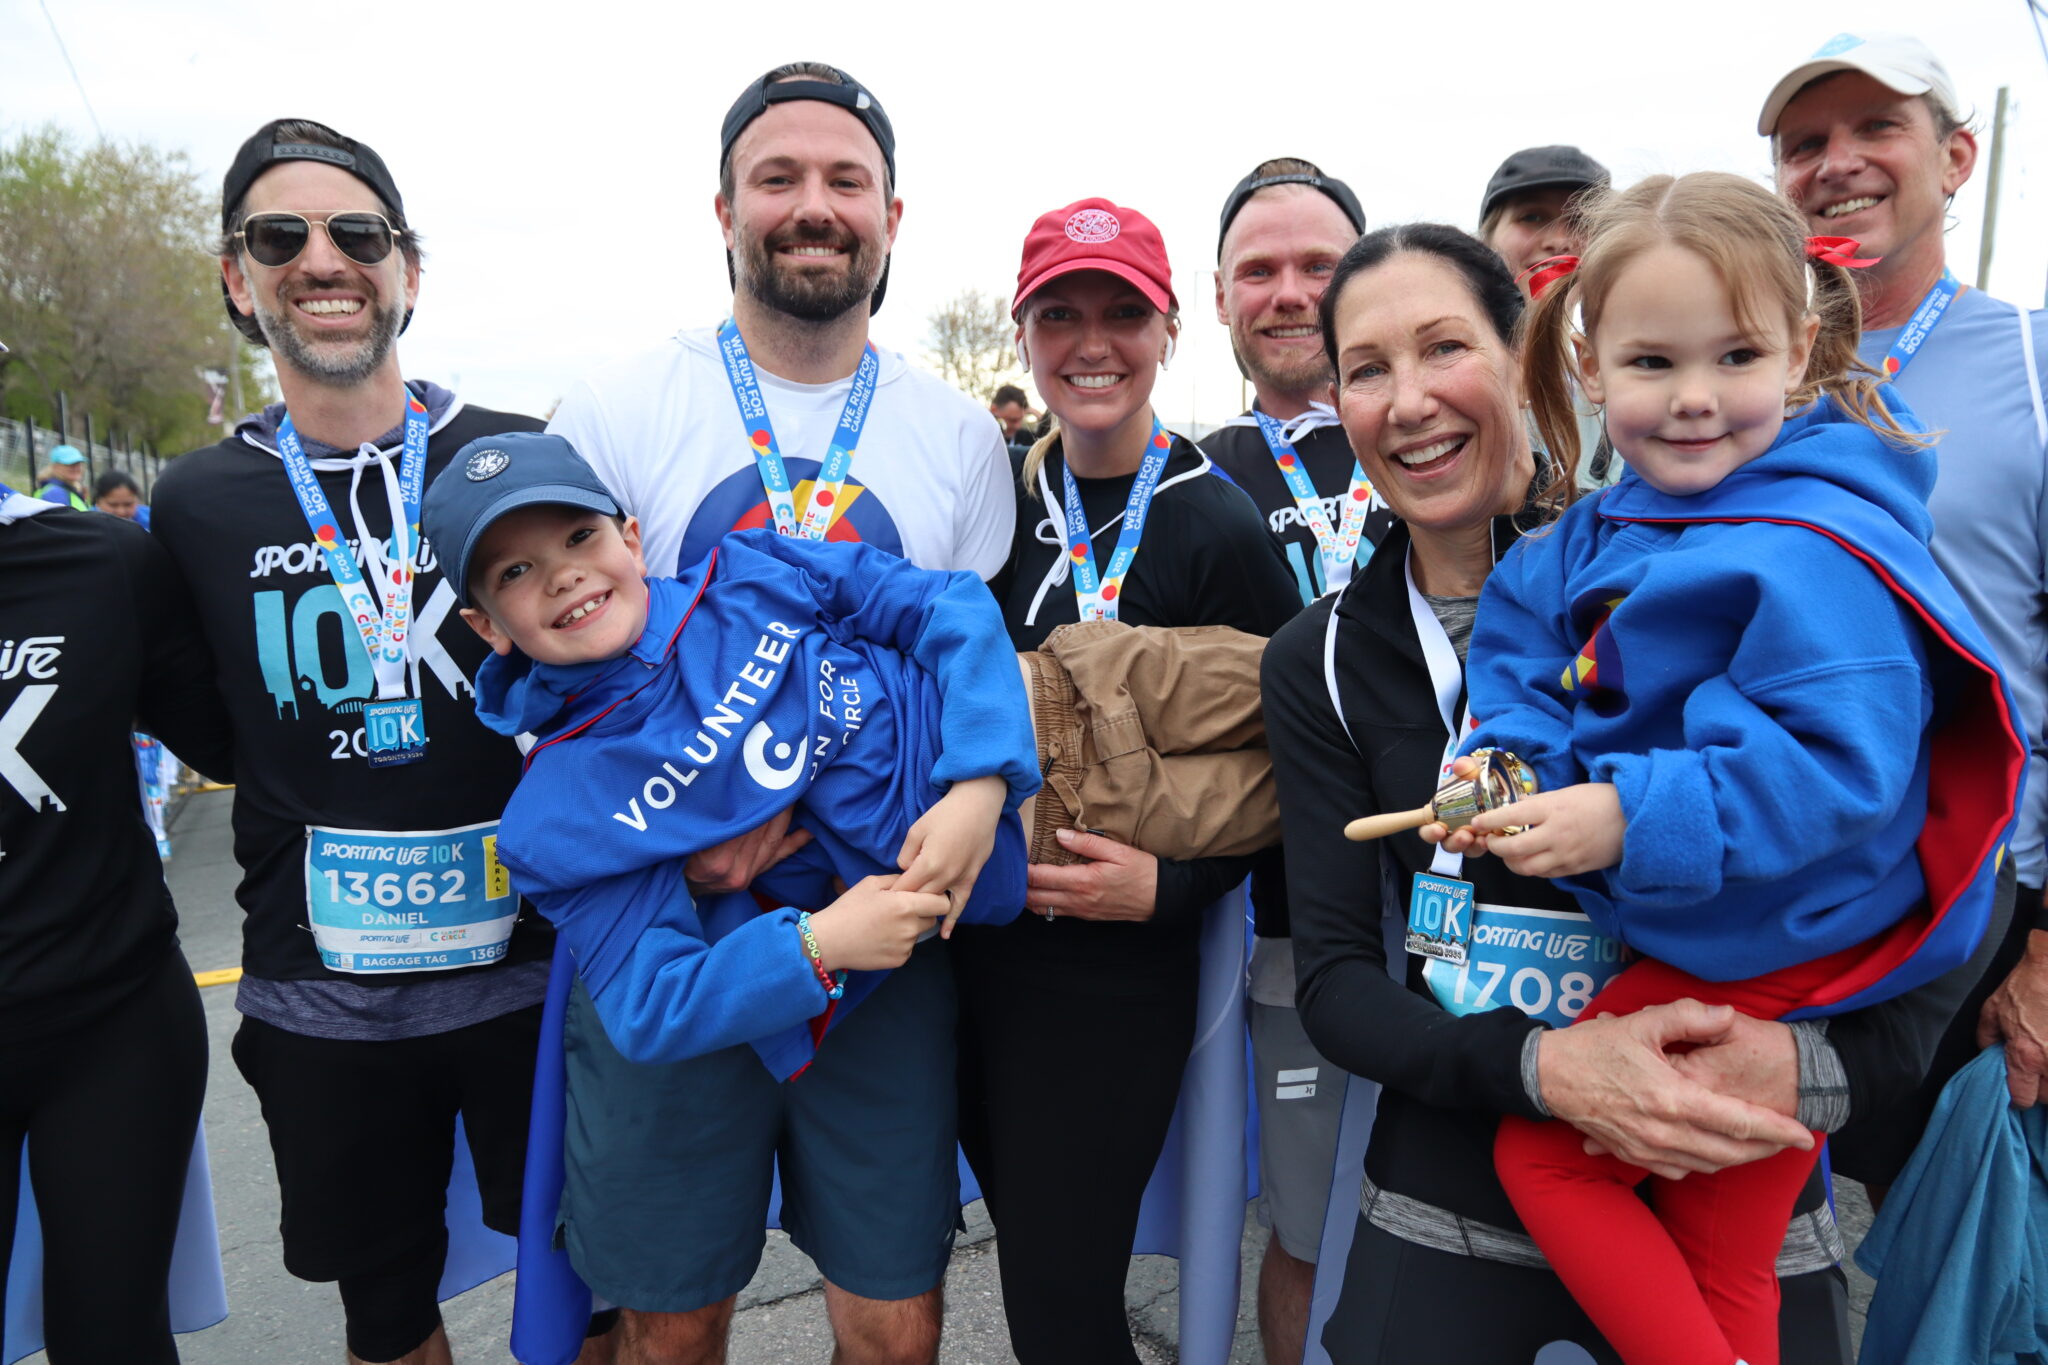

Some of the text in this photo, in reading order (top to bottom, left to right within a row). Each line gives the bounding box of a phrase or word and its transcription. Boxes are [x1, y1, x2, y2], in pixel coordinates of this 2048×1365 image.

[1896, 322, 1919, 350] CIRCLE
[1904, 293, 1951, 355] WE RUN FOR
[722, 340, 754, 420] CAMPFIRE CIRCLE
[730, 333, 765, 418] WE RUN FOR
[840, 352, 871, 429] WE RUN FOR
[850, 358, 877, 432] CAMPFIRE CIRCLE
[279, 439, 317, 518] CAMPFIRE CIRCLE
[286, 431, 327, 514] WE RUN FOR
[400, 418, 419, 503] WE RUN FOR
[410, 421, 426, 504] CAMPFIRE CIRCLE
[766, 459, 782, 487] 2024
[828, 450, 844, 477] 2024
[1070, 484, 1080, 509] RUN
[1124, 455, 1155, 531] WE RUN FOR
[1133, 457, 1164, 530] CAMPFIRE CIRCLE
[1292, 475, 1309, 496] 2024
[1067, 510, 1077, 537] CIRCLE
[1074, 509, 1085, 534] FOR
[1346, 508, 1364, 547] CIRCLE
[333, 552, 354, 580] 2024
[1081, 567, 1093, 590] 2024
[1112, 551, 1128, 573] 2024
[383, 593, 396, 641] CAMPFIRE
[392, 594, 409, 642] CIRCLE
[819, 660, 836, 720] FOR
[370, 713, 421, 747] 10K
[612, 621, 800, 832] VOLUNTEER
[432, 842, 465, 864] 10K
[323, 869, 466, 907] 13662
[362, 912, 429, 925] DANIEL
[1415, 892, 1468, 937] 10K
[362, 956, 421, 966] BAGGAGE
[424, 954, 448, 964] TAG
[469, 943, 510, 961] 13662
[441, 933, 467, 942] CIRCLE
[1453, 959, 1622, 1019] 1708
